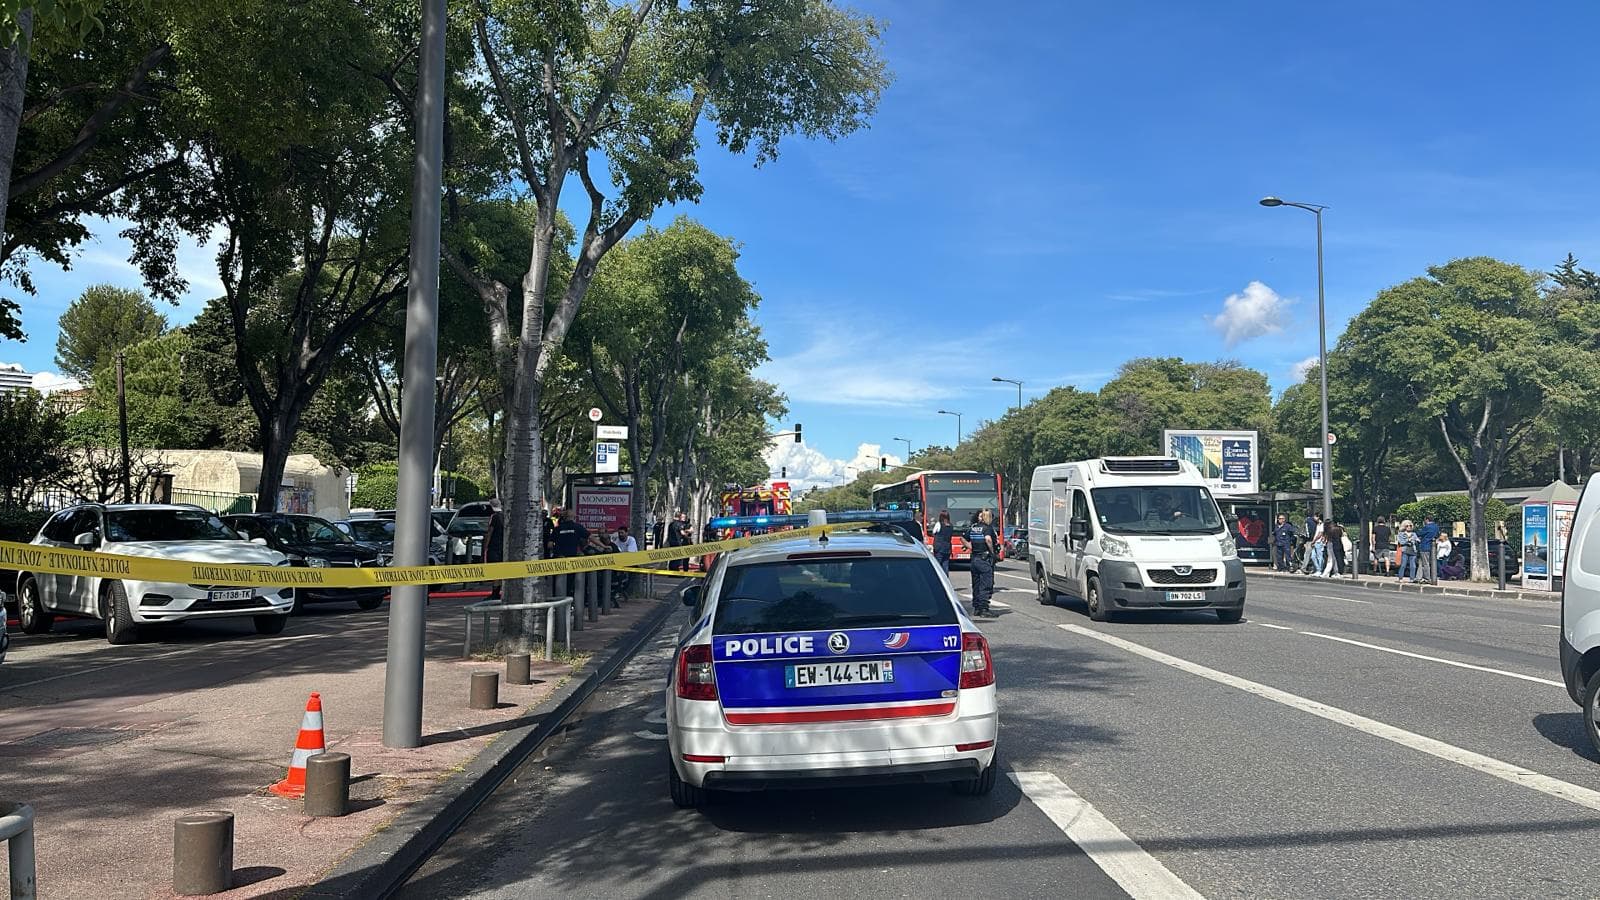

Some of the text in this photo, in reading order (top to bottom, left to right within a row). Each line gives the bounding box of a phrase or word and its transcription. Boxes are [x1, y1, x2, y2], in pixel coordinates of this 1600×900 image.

[581, 495, 626, 504] MONOPRIX
[17, 547, 42, 567] ZONE
[49, 552, 98, 572] NATIONALE
[100, 557, 130, 574] POLICE
[191, 566, 323, 583] POLICE NATIONALE ZONE INTERDITE
[373, 566, 485, 583] POLICE NATIONALE ZONE INTERDITE
[725, 636, 814, 657] POLICE
[797, 663, 880, 685] EW-144-CM
